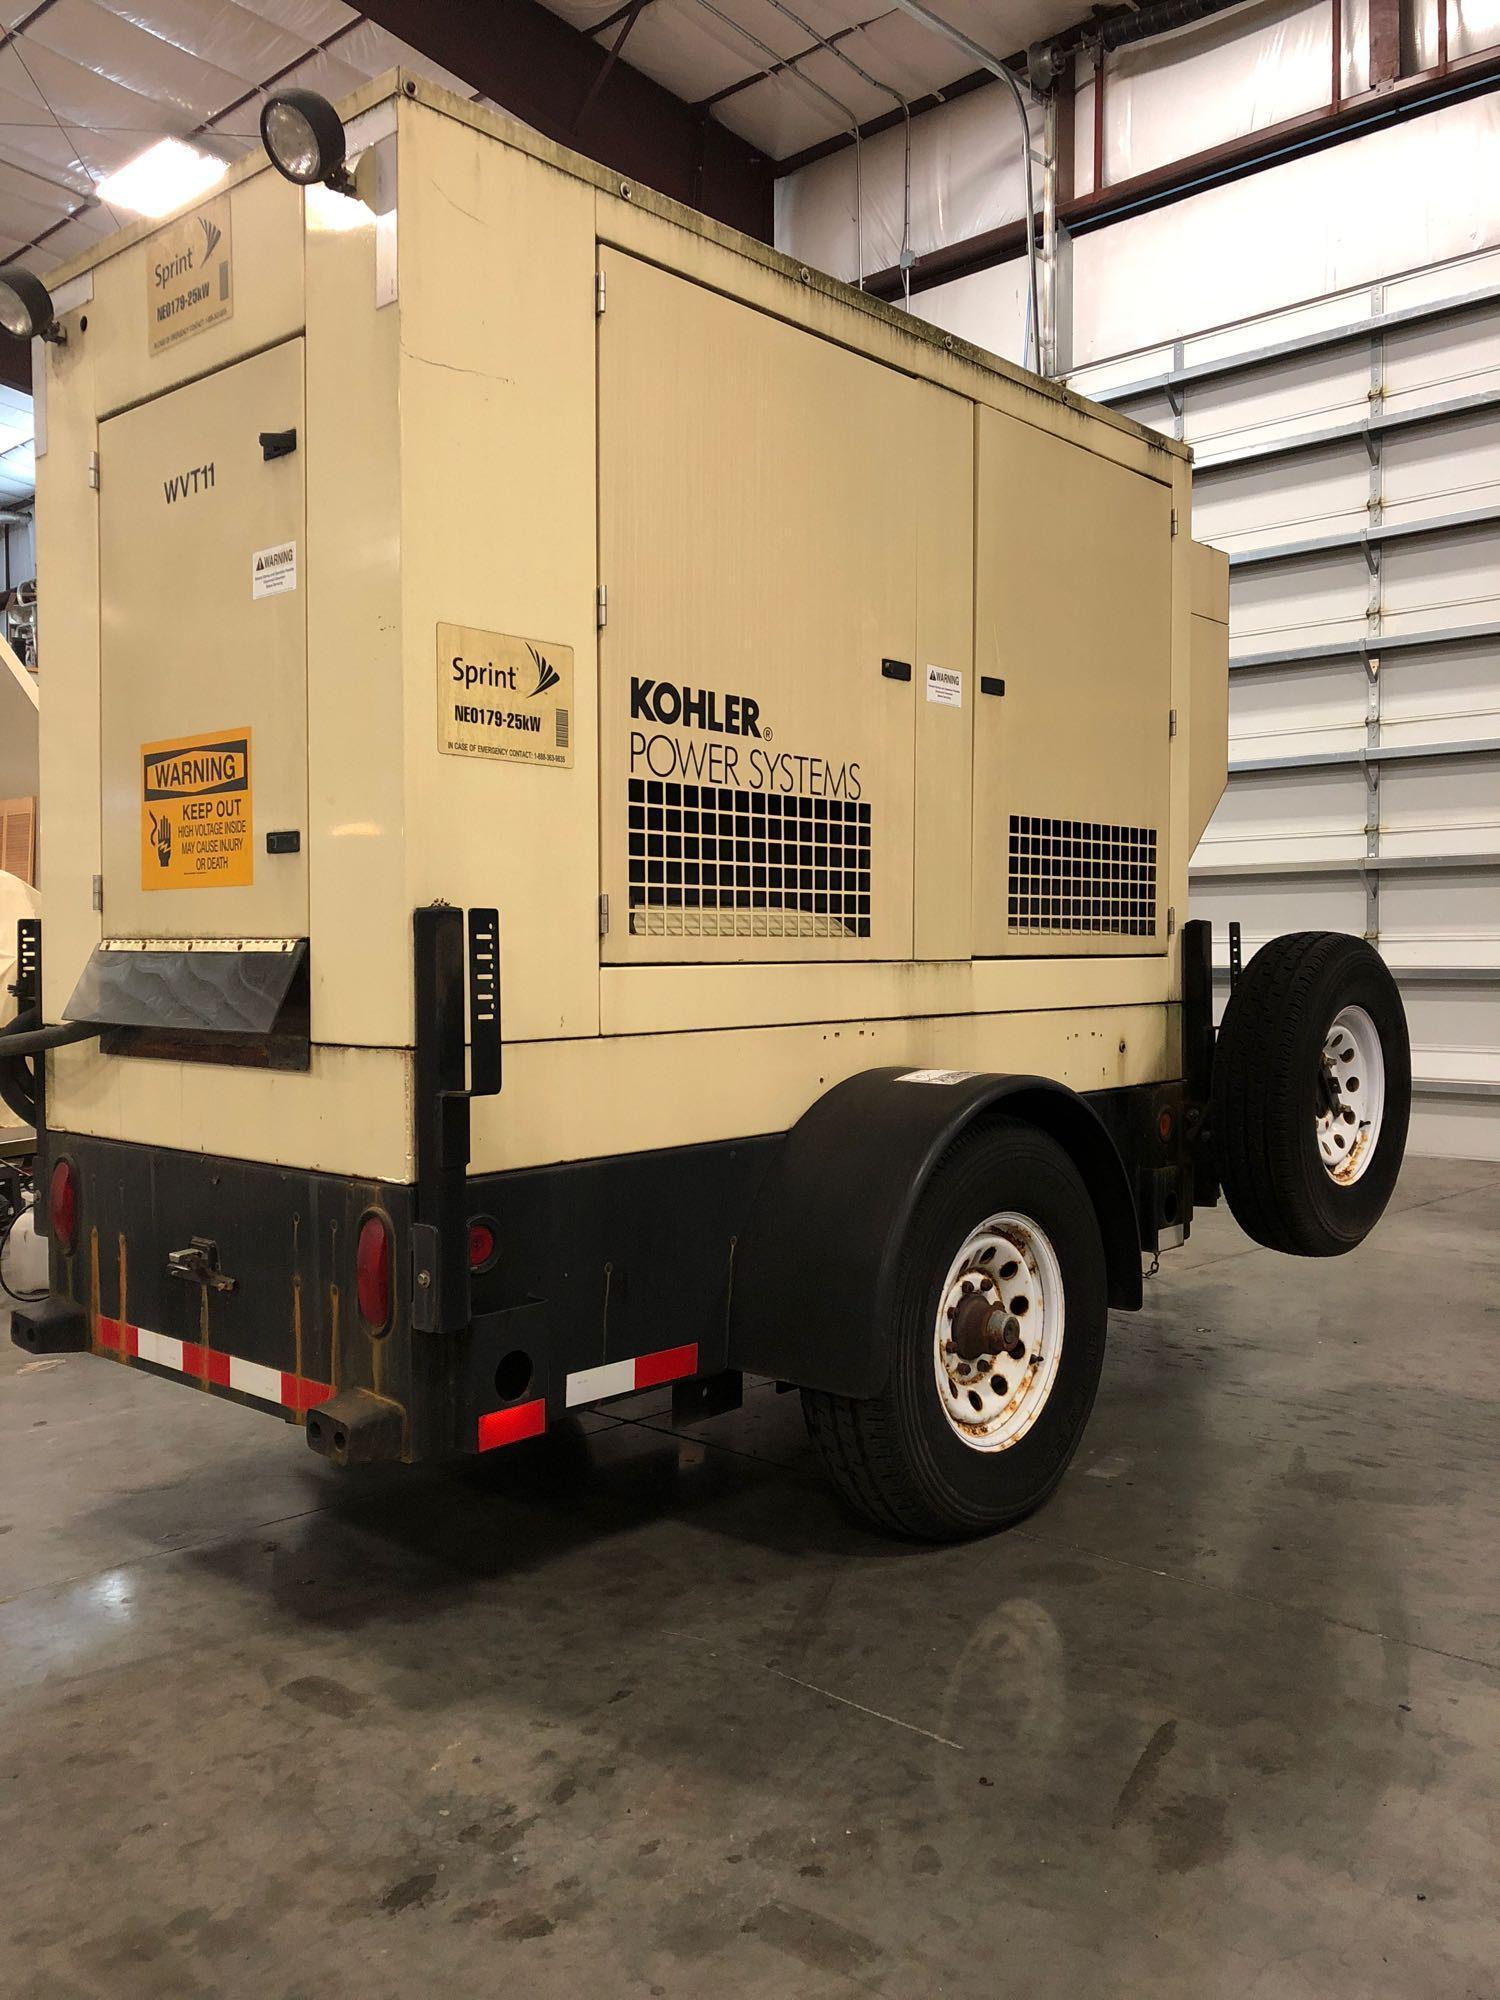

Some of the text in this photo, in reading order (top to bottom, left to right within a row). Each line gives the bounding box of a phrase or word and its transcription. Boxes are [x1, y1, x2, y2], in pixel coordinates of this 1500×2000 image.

[154, 247, 193, 289] Sprint
[163, 461, 215, 504] WVT11
[263, 548, 293, 568] WARNING
[452, 656, 517, 690] Sprint
[935, 671, 960, 686] WARNING
[454, 704, 541, 732] NE0179-25kW
[630, 676, 762, 738] KOHLER
[447, 741, 454, 750] IN
[454, 742, 469, 751] CASE
[469, 743, 477, 752] OF
[477, 744, 508, 756] EMERGENCY
[155, 753, 236, 788] WARNING
[630, 731, 862, 800] POWER SYSTEMS
[182, 799, 242, 821] KEEP OUT
[177, 820, 247, 838] HIGH VOLTAGE INSIDE
[181, 837, 244, 854] MAY CAUSE INJURY
[195, 856, 229, 870] OR DEATH
